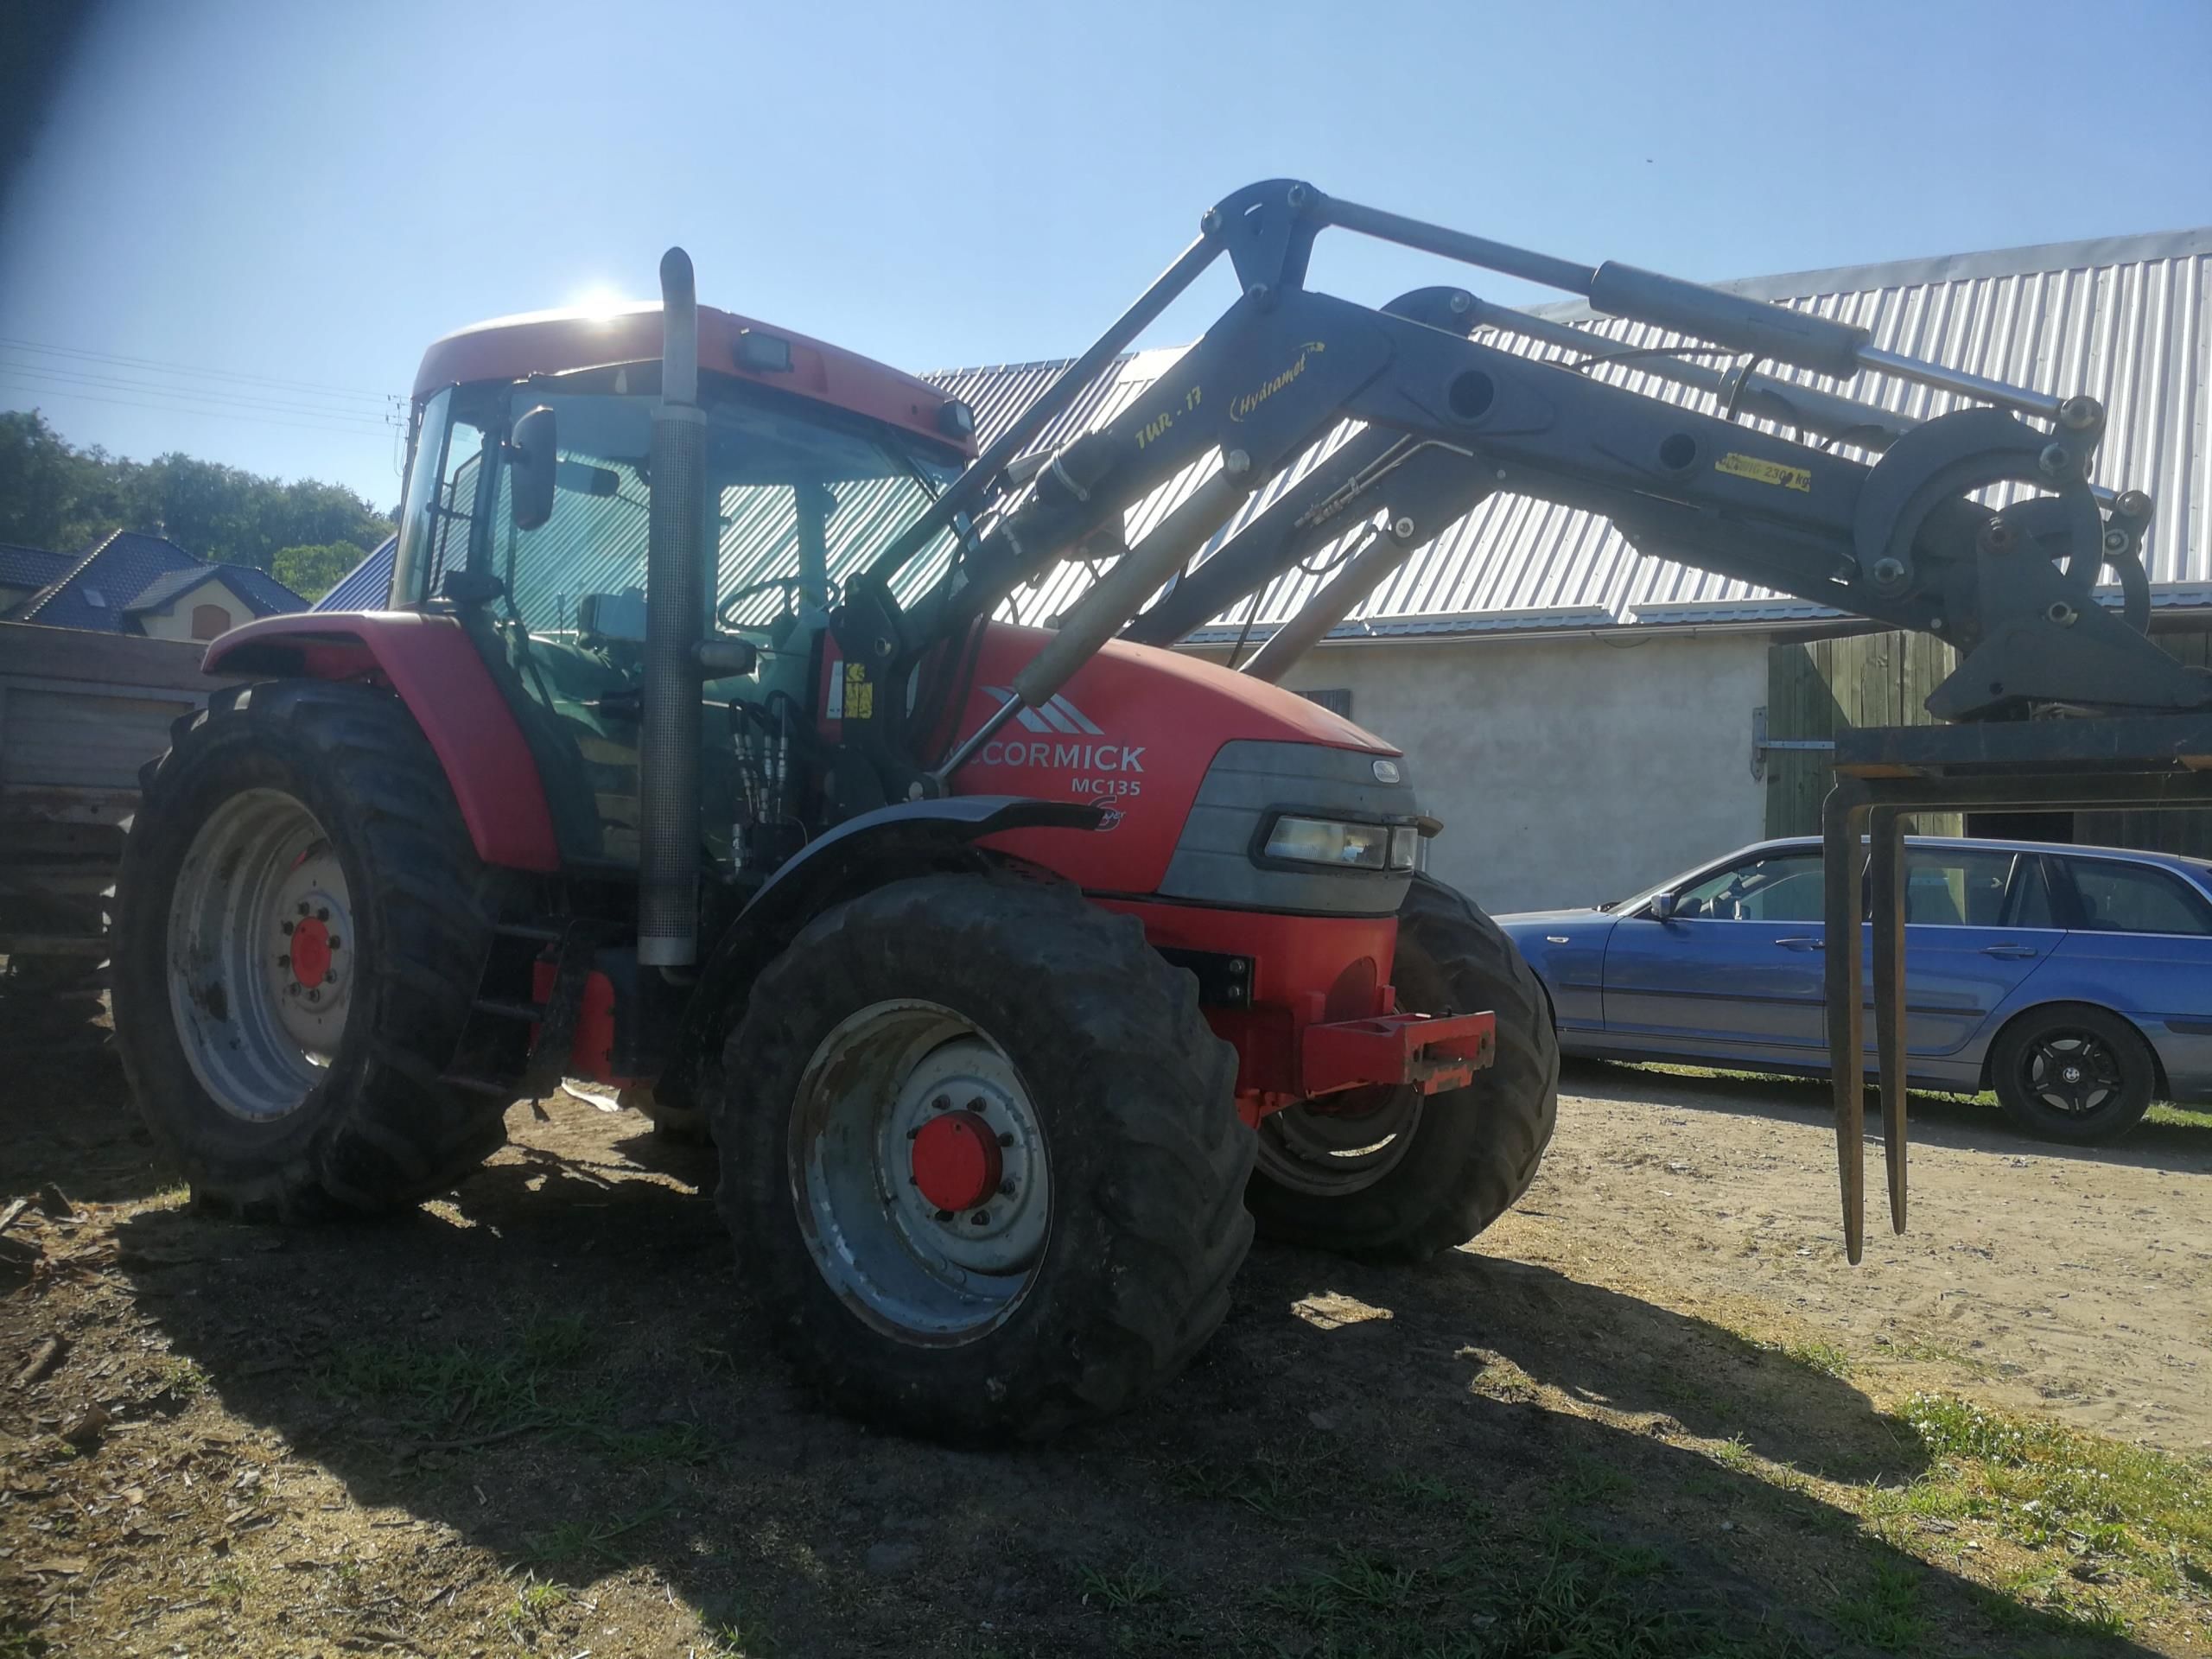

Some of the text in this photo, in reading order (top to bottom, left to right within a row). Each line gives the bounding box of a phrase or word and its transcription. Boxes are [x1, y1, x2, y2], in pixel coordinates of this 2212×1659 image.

[1135, 411, 1173, 449] TUR
[1185, 385, 1202, 411] 17
[943, 740, 1147, 772] CORMICK
[1071, 778, 1141, 796] MC135
